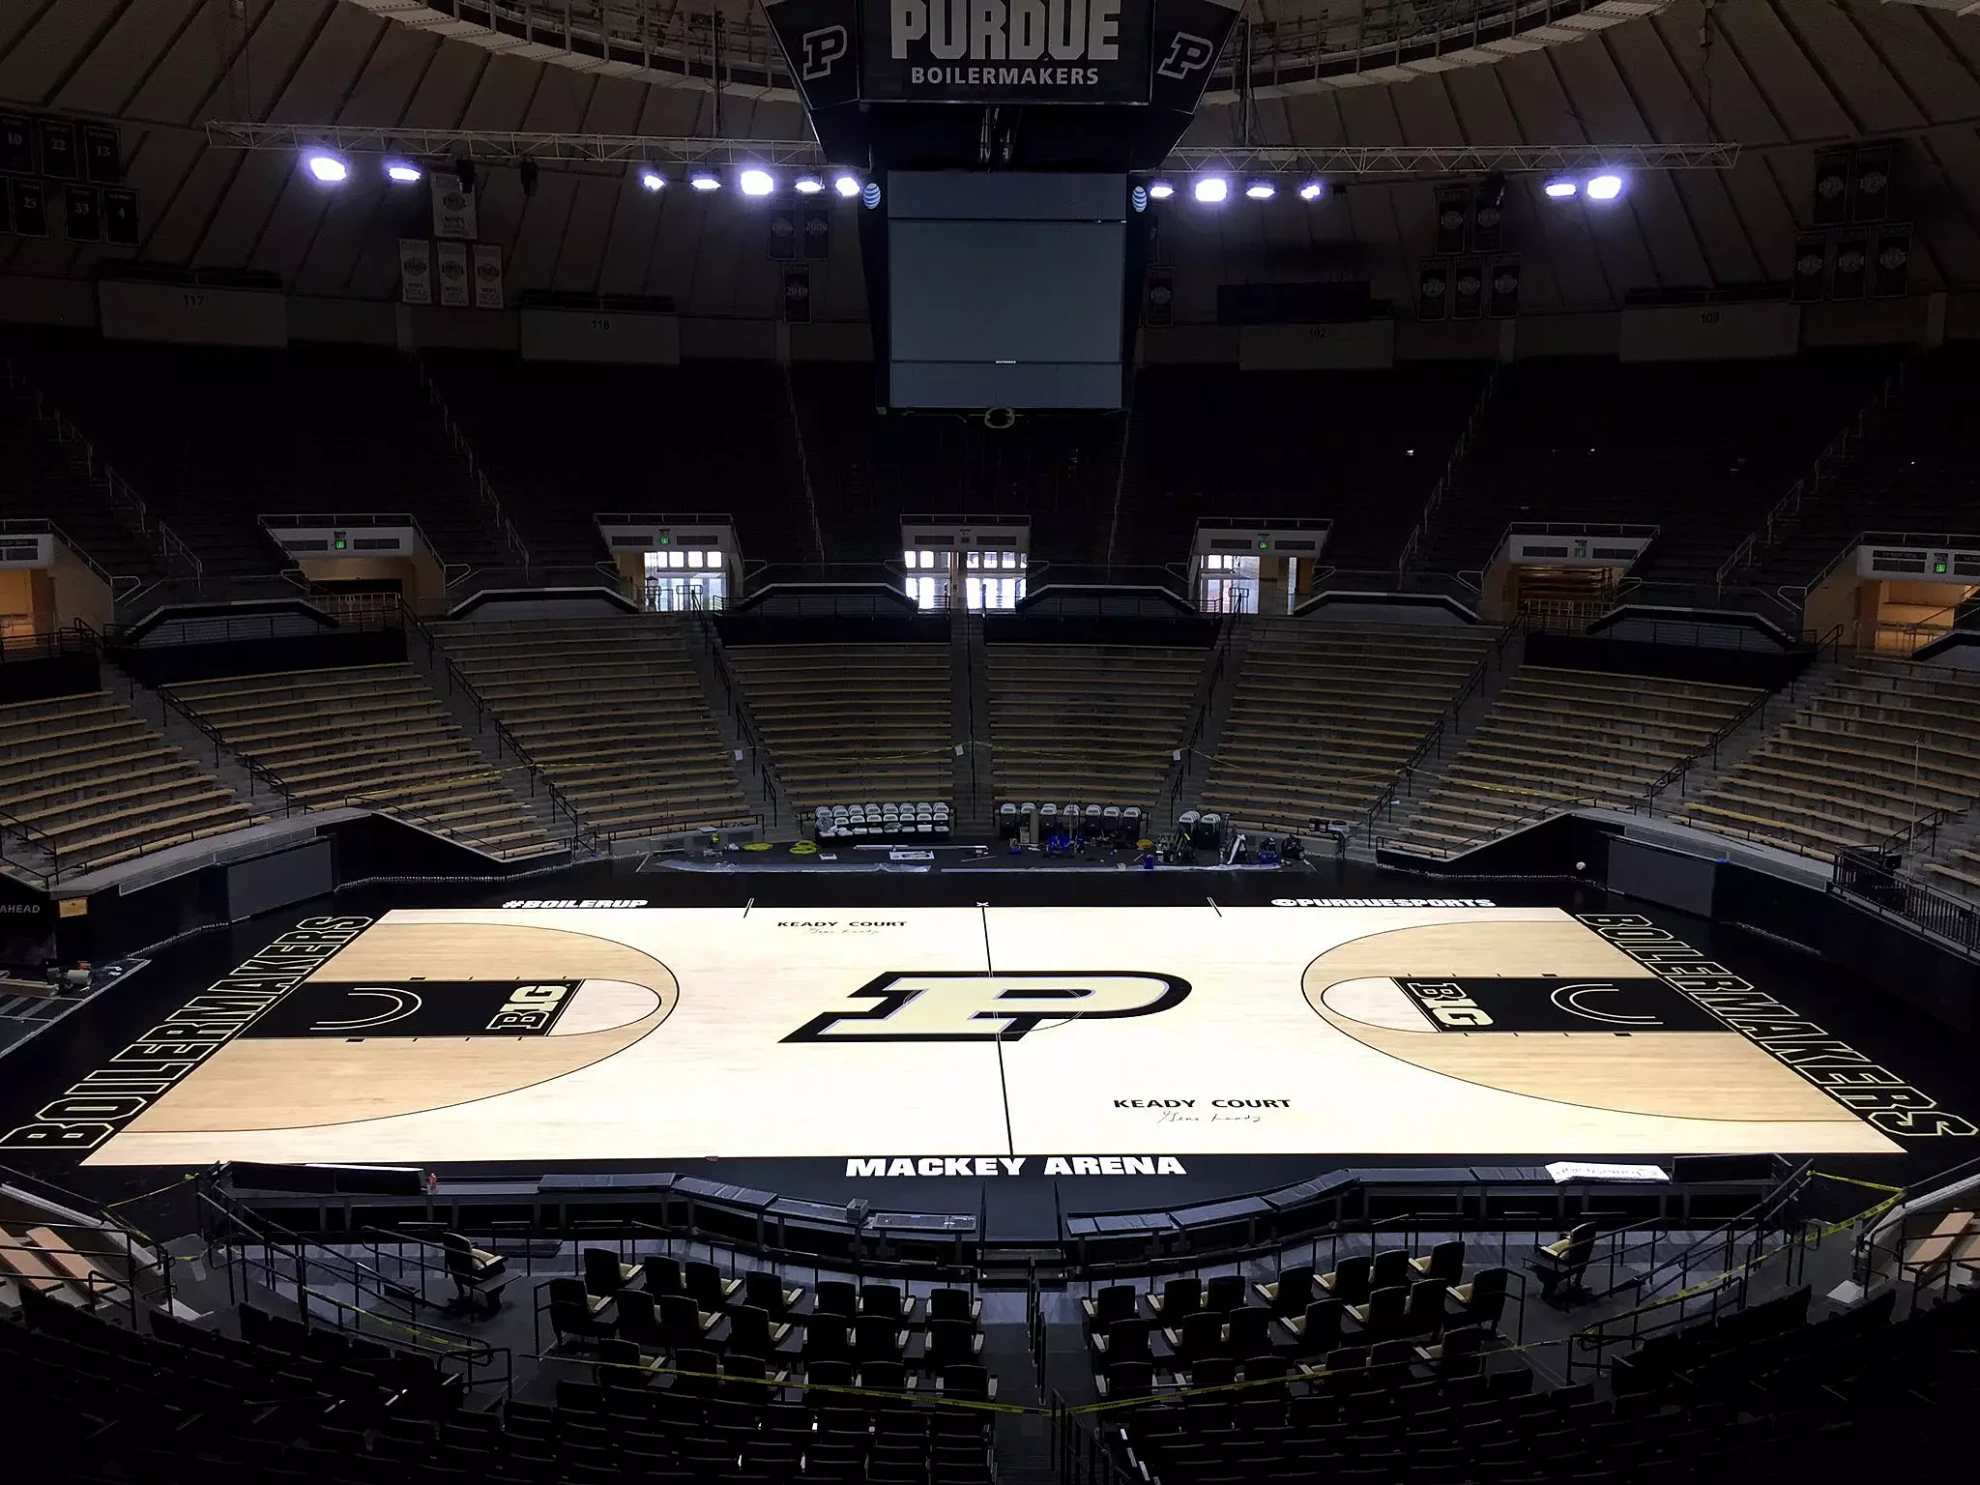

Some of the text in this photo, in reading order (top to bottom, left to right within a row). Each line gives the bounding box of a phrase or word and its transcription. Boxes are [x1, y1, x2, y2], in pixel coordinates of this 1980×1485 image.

[891, 0, 1121, 61] PURDUE
[803, 24, 847, 81] P
[1157, 31, 1214, 79] P
[911, 67, 1098, 85] BOILERMAKERS
[592, 319, 611, 331] 118
[0, 904, 41, 915] AHEAD
[502, 899, 649, 909] #BOILERUP
[1270, 898, 1497, 908] @PURDUESPORTS
[777, 971, 1192, 1043] P
[0, 915, 374, 1150] BOILERMAKERS
[1575, 914, 1979, 1137] BOILERMAKERS
[1113, 1099, 1291, 1108] KEADY COURT
[845, 1156, 1187, 1177] MACKEY ARENA
